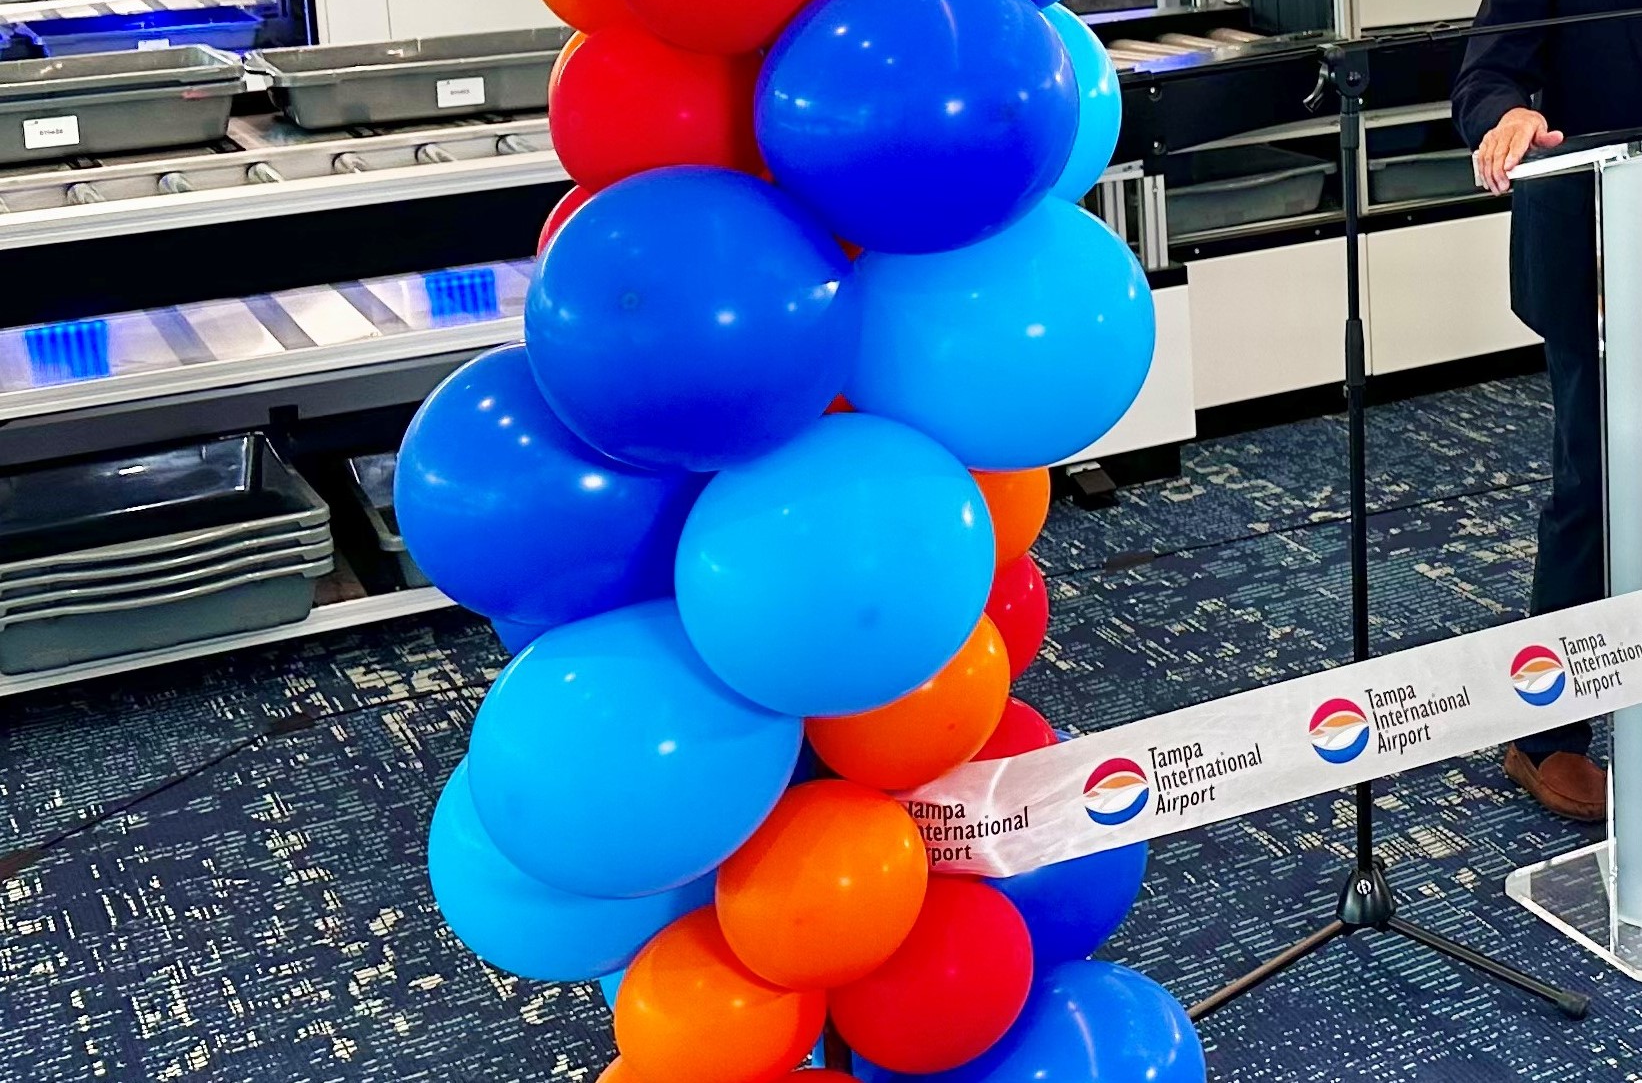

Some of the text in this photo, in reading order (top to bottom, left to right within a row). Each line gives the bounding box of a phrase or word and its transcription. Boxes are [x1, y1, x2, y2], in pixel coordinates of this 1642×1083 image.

[1558, 633, 1607, 657] Tampa
[1364, 684, 1417, 710] Tampa
[1573, 669, 1623, 699] Airport
[1372, 685, 1471, 731] International
[1377, 723, 1432, 755] Airport
[1147, 742, 1204, 770] Tampa
[1153, 742, 1263, 793] International
[1155, 783, 1216, 816] Airport
